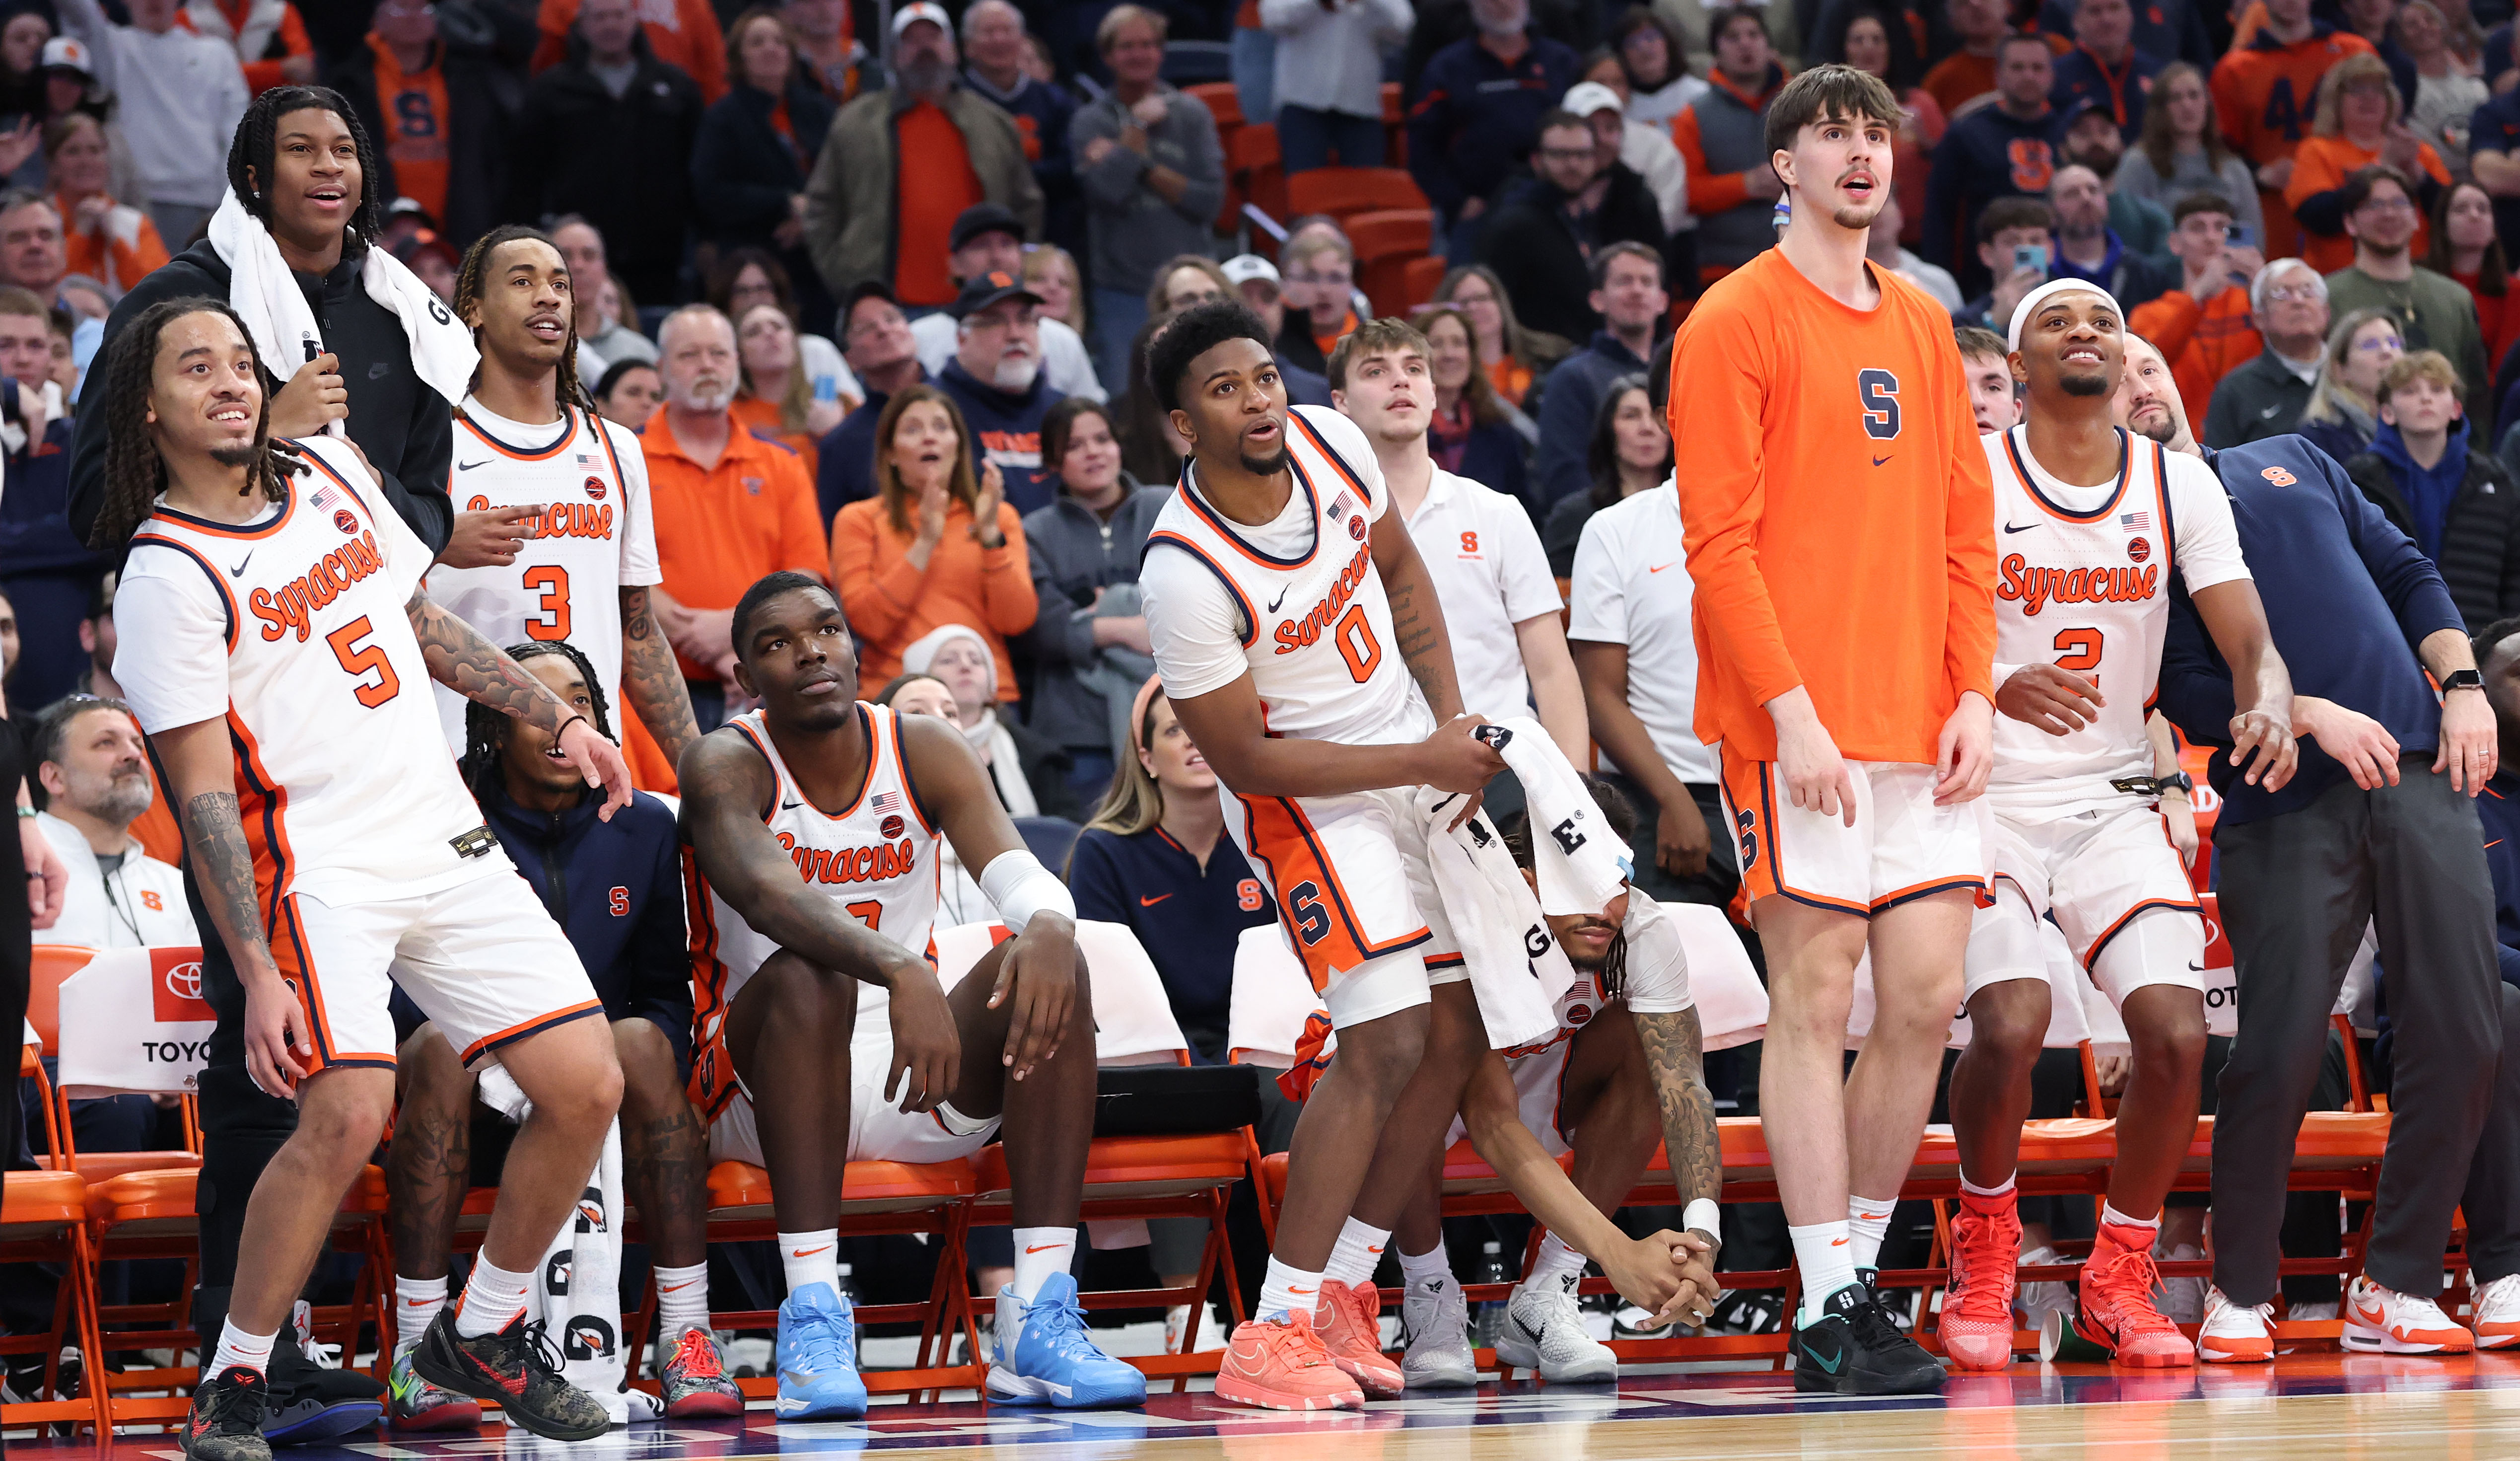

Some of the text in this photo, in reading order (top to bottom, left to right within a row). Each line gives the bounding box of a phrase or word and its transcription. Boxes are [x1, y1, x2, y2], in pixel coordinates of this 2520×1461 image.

[1858, 368, 1901, 440] S
[2260, 466, 2298, 487] S
[468, 495, 613, 540] acuse
[1461, 531, 1478, 552] S
[249, 529, 383, 643] Syracuse
[523, 565, 571, 642] 3
[1274, 541, 1370, 655] Syracus
[1997, 553, 2158, 616] Syracuse
[325, 614, 400, 709] 5
[1335, 604, 1382, 683] 0
[2052, 627, 2104, 698] 2
[140, 890, 163, 912] S
[609, 885, 630, 917] S
[1237, 878, 1263, 912] S
[1289, 880, 1332, 947] S
[142, 1041, 209, 1062] TOYO
